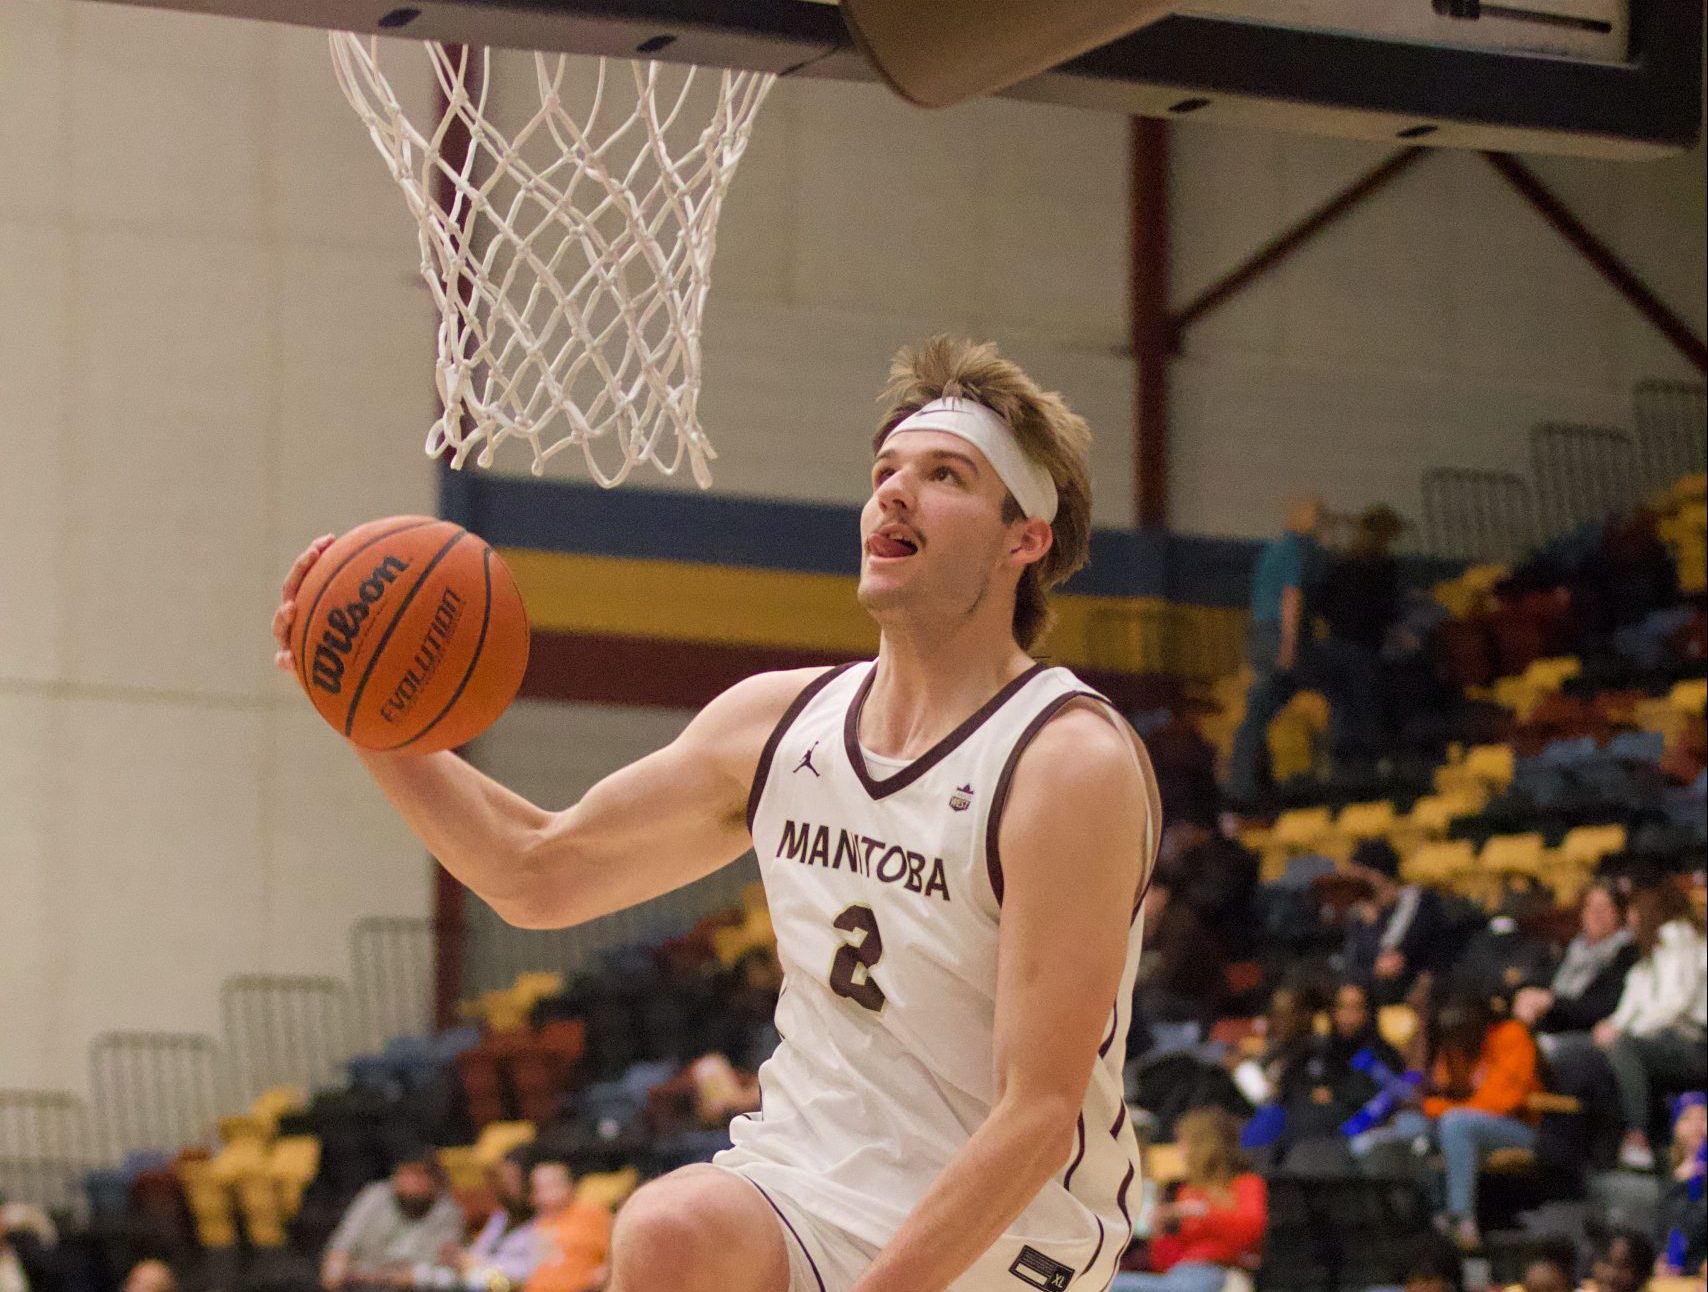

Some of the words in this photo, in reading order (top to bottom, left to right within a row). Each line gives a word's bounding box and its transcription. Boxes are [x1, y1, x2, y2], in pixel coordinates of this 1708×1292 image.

[312, 555, 410, 694] Wilson
[380, 586, 462, 722] EVOLUTION
[776, 819, 951, 901] MANITOBA
[829, 902, 887, 1013] 2
[1051, 1273, 1065, 1289] XL
